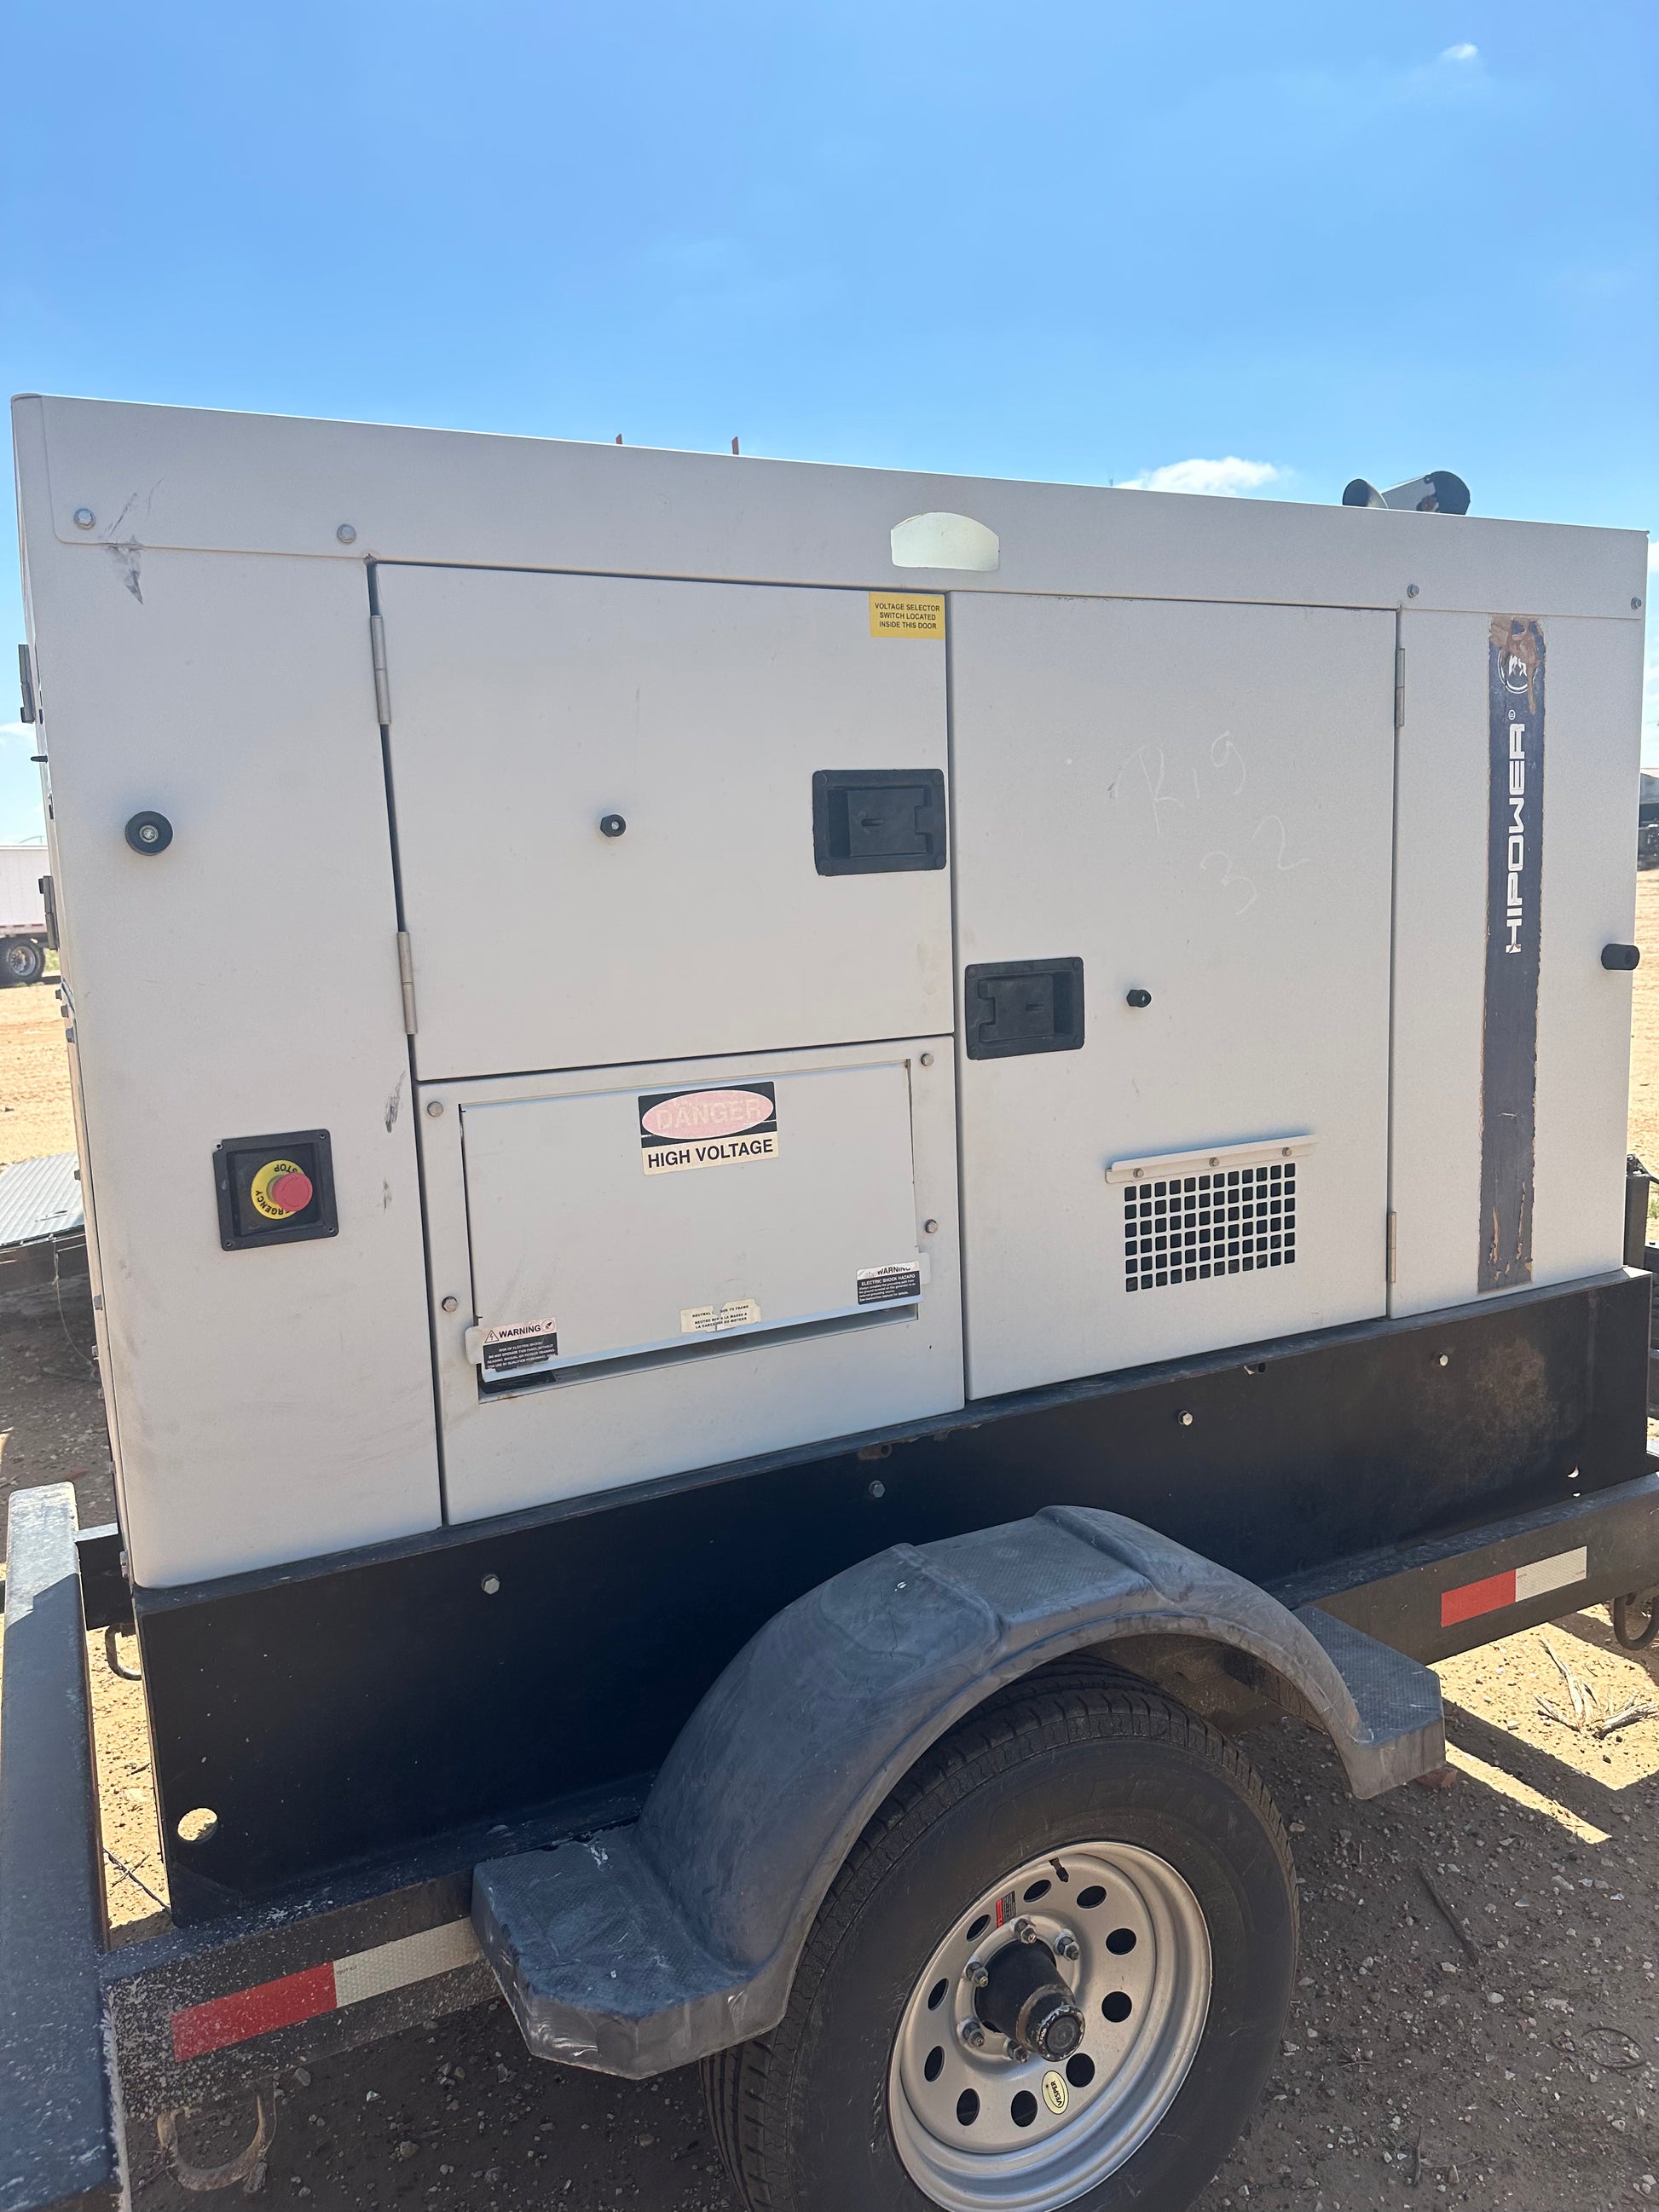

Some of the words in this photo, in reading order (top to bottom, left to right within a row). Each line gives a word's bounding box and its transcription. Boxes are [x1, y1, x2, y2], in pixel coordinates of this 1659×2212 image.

[875, 602, 905, 610] VOLTAGE
[906, 604, 940, 612] SELECTOR
[1506, 723, 1526, 954] HIPOWER
[1199, 814, 1311, 916] 32
[655, 1098, 762, 1130] DANGER
[648, 1149, 691, 1168] HIGH
[695, 1139, 773, 1162] VOLTAGE
[499, 1325, 541, 1338] WARNING
[1050, 2080, 1063, 2106] VESPER
